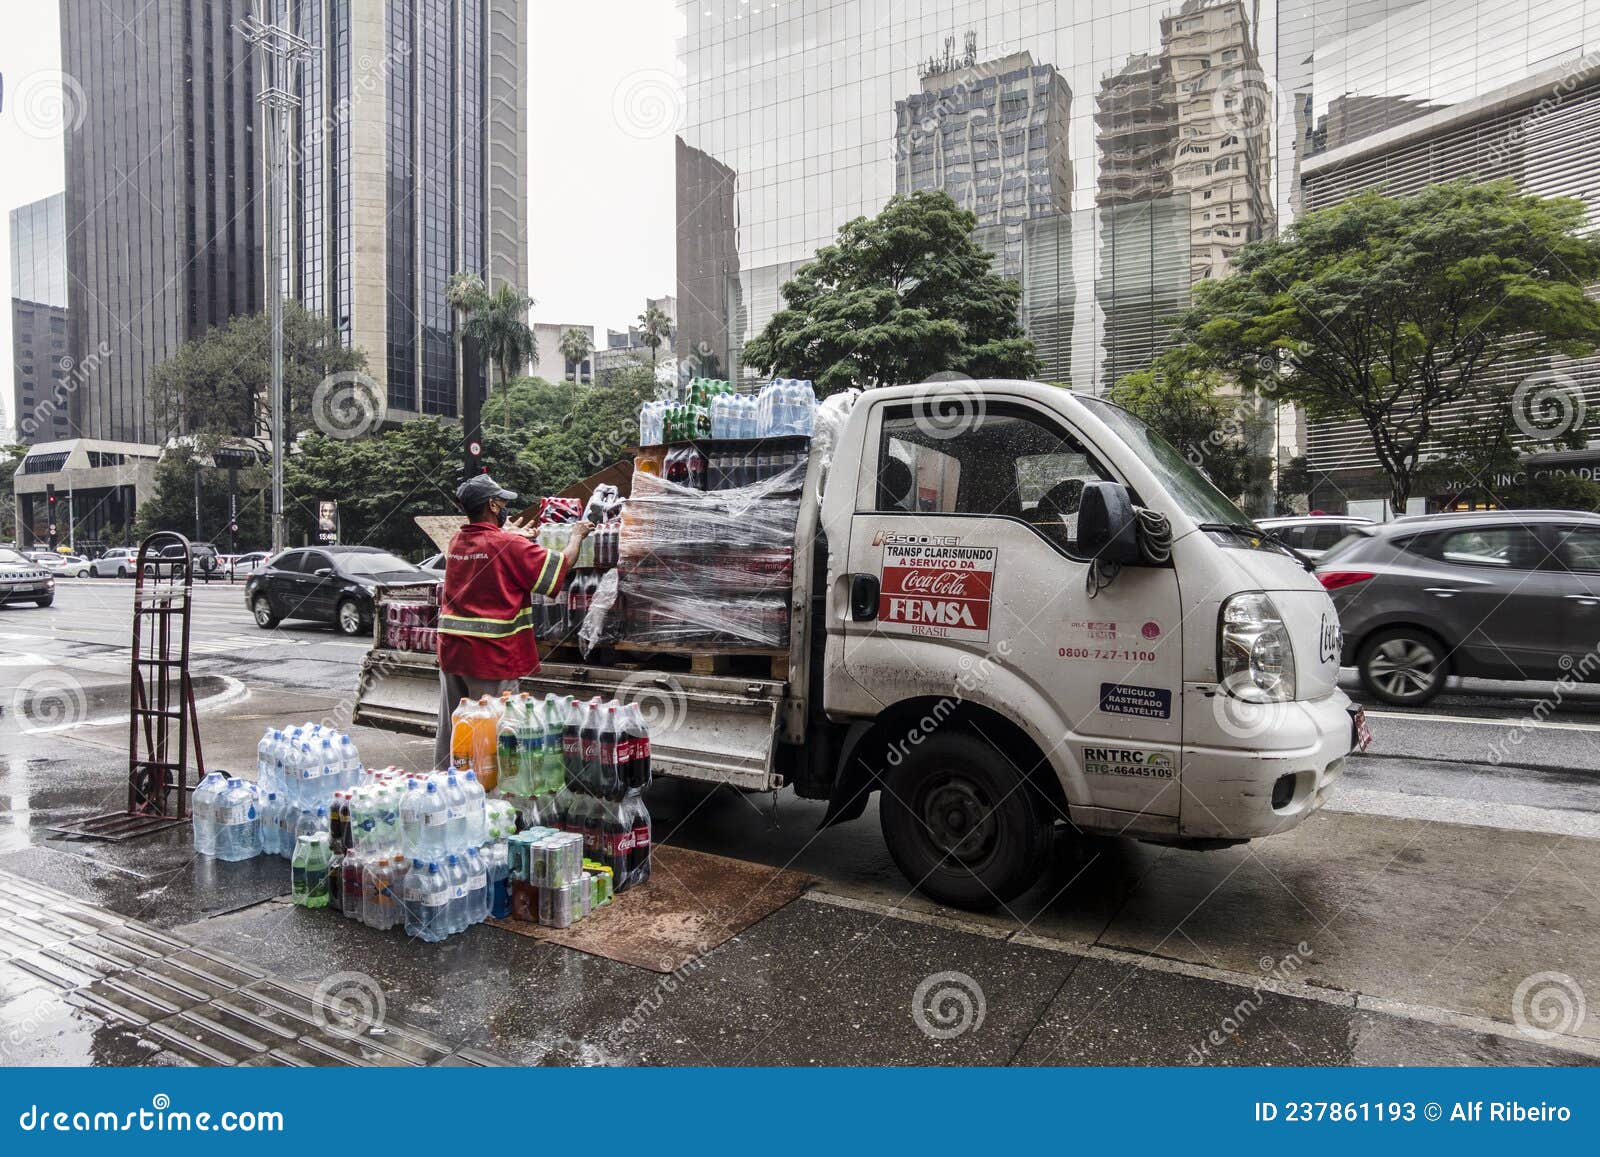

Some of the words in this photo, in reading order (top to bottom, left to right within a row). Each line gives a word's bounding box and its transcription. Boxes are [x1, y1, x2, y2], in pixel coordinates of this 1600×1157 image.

[887, 546, 922, 557] TRANSP
[924, 547, 993, 560] CLARISMUNDO
[899, 557, 907, 566] A
[909, 558, 957, 569] SERVIÇO
[960, 560, 975, 569] DA
[901, 569, 970, 596] Coca-Cola
[889, 597, 977, 627] FEMSA
[911, 625, 951, 638] BRASIL
[1058, 647, 1156, 662] 0800-727-1100
[1105, 703, 1120, 712] VIA
[1109, 695, 1163, 708] RASTREADO
[1084, 748, 1144, 763] RNTRC
[1085, 763, 1173, 778] ETC-46445109
